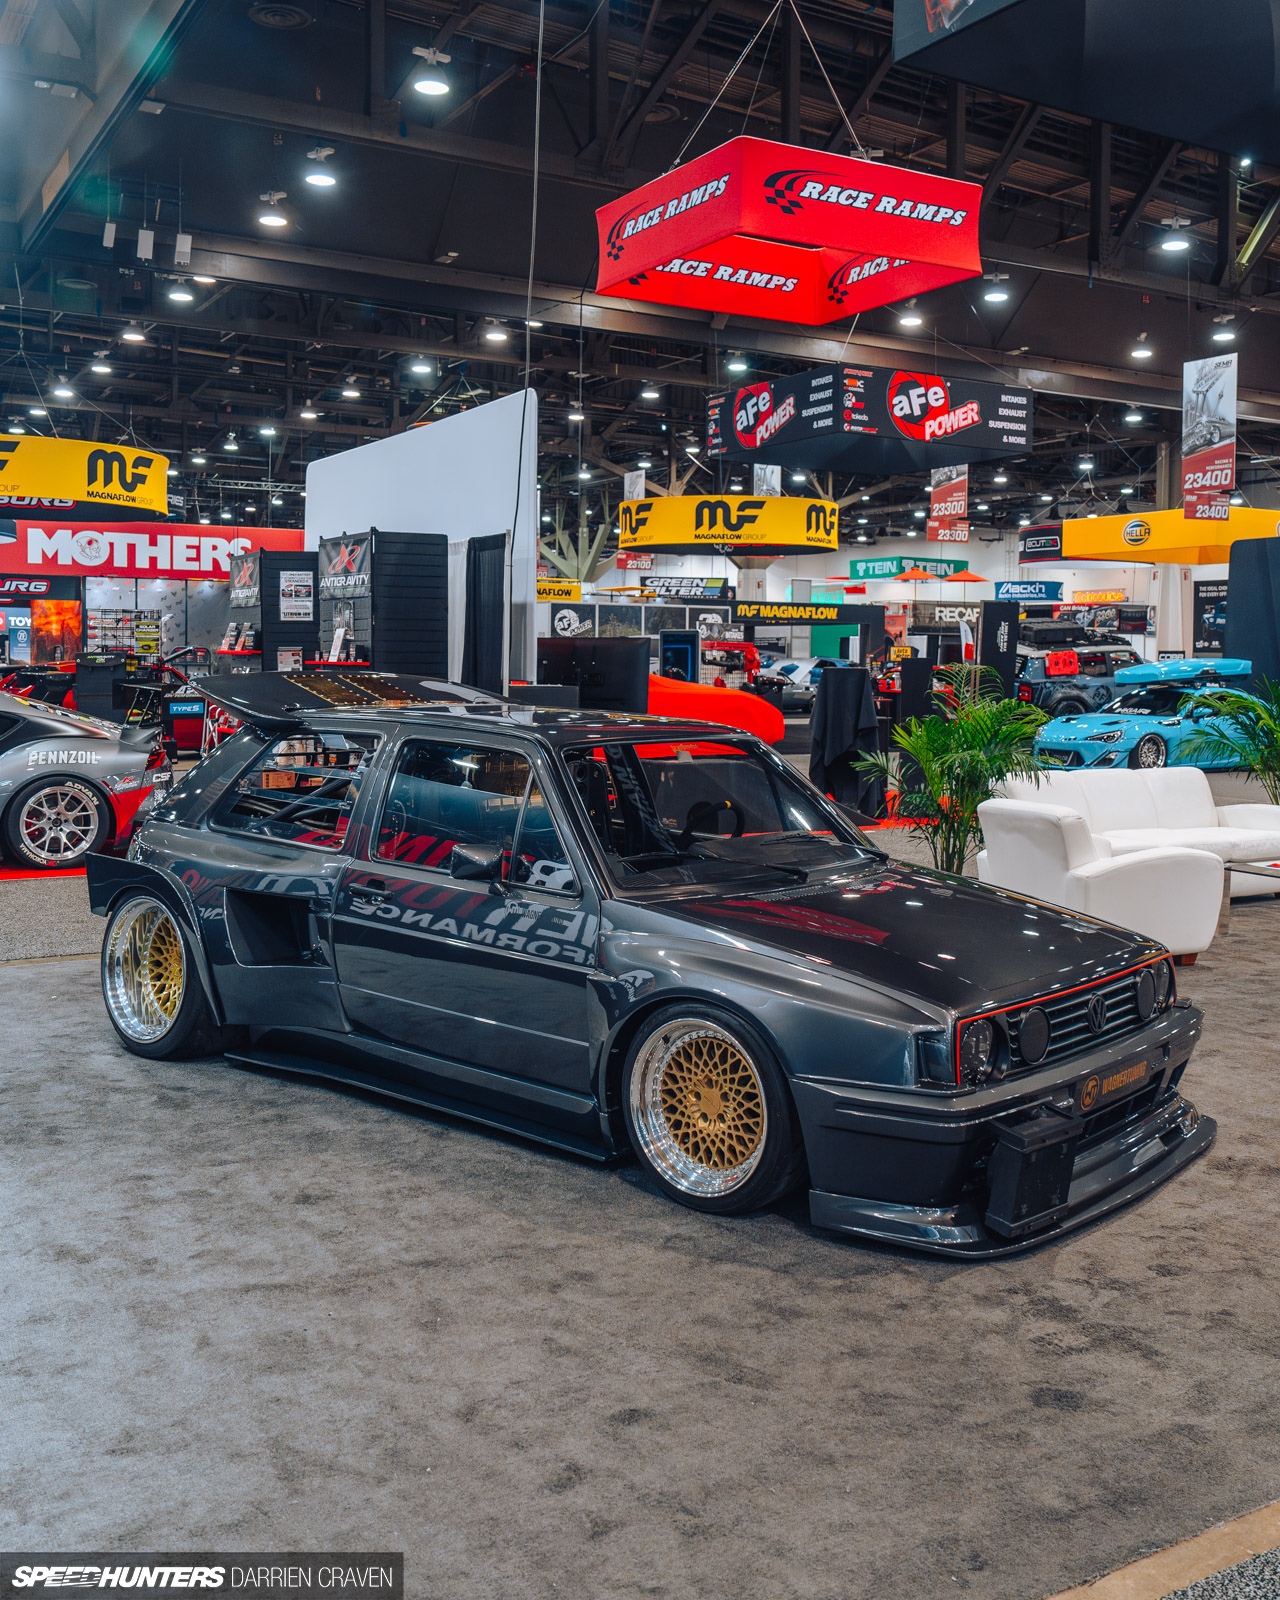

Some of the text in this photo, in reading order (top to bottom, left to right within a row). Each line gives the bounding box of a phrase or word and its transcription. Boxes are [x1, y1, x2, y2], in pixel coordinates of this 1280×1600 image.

[621, 172, 731, 240] RACE RAMPS
[798, 180, 968, 226] RACE RAMPS
[711, 264, 800, 292] RAMPS
[811, 375, 833, 387] INTAKES
[809, 389, 833, 401] EXHAUST
[892, 386, 945, 418] aFe
[1001, 394, 1027, 405] INTAKES
[736, 391, 770, 431] aFe
[802, 404, 833, 417] SUSPENSION
[998, 408, 1027, 418] EXHAUST
[756, 395, 796, 448] POWER
[817, 418, 833, 428] MORE
[924, 401, 980, 442] POWER
[988, 420, 1027, 431] SUSPENSION
[1002, 435, 1027, 444] & MORE
[1184, 469, 1231, 489] 23400
[87, 490, 136, 503] MAGNAFLOW
[932, 501, 965, 516] 23300
[1196, 505, 1229, 518] 23400
[937, 529, 968, 541] 23300
[1126, 528, 1150, 539] HELLA
[627, 560, 651, 569] 23100
[867, 560, 897, 575] TEIN
[916, 561, 954, 576] TEIN
[320, 574, 370, 588] ANTIGRAVITY
[645, 578, 708, 587] GREEN
[1074, 591, 1123, 603] Concourse
[760, 606, 838, 620] MAGNAFLOW
[557, 616, 578, 630] aFe
[569, 619, 592, 637] POWER
[27, 750, 99, 766] PENNZOIL
[152, 772, 171, 783] CSF
[64, 781, 99, 806] ADVAN
[19, 843, 47, 866] YOKOHAMA
